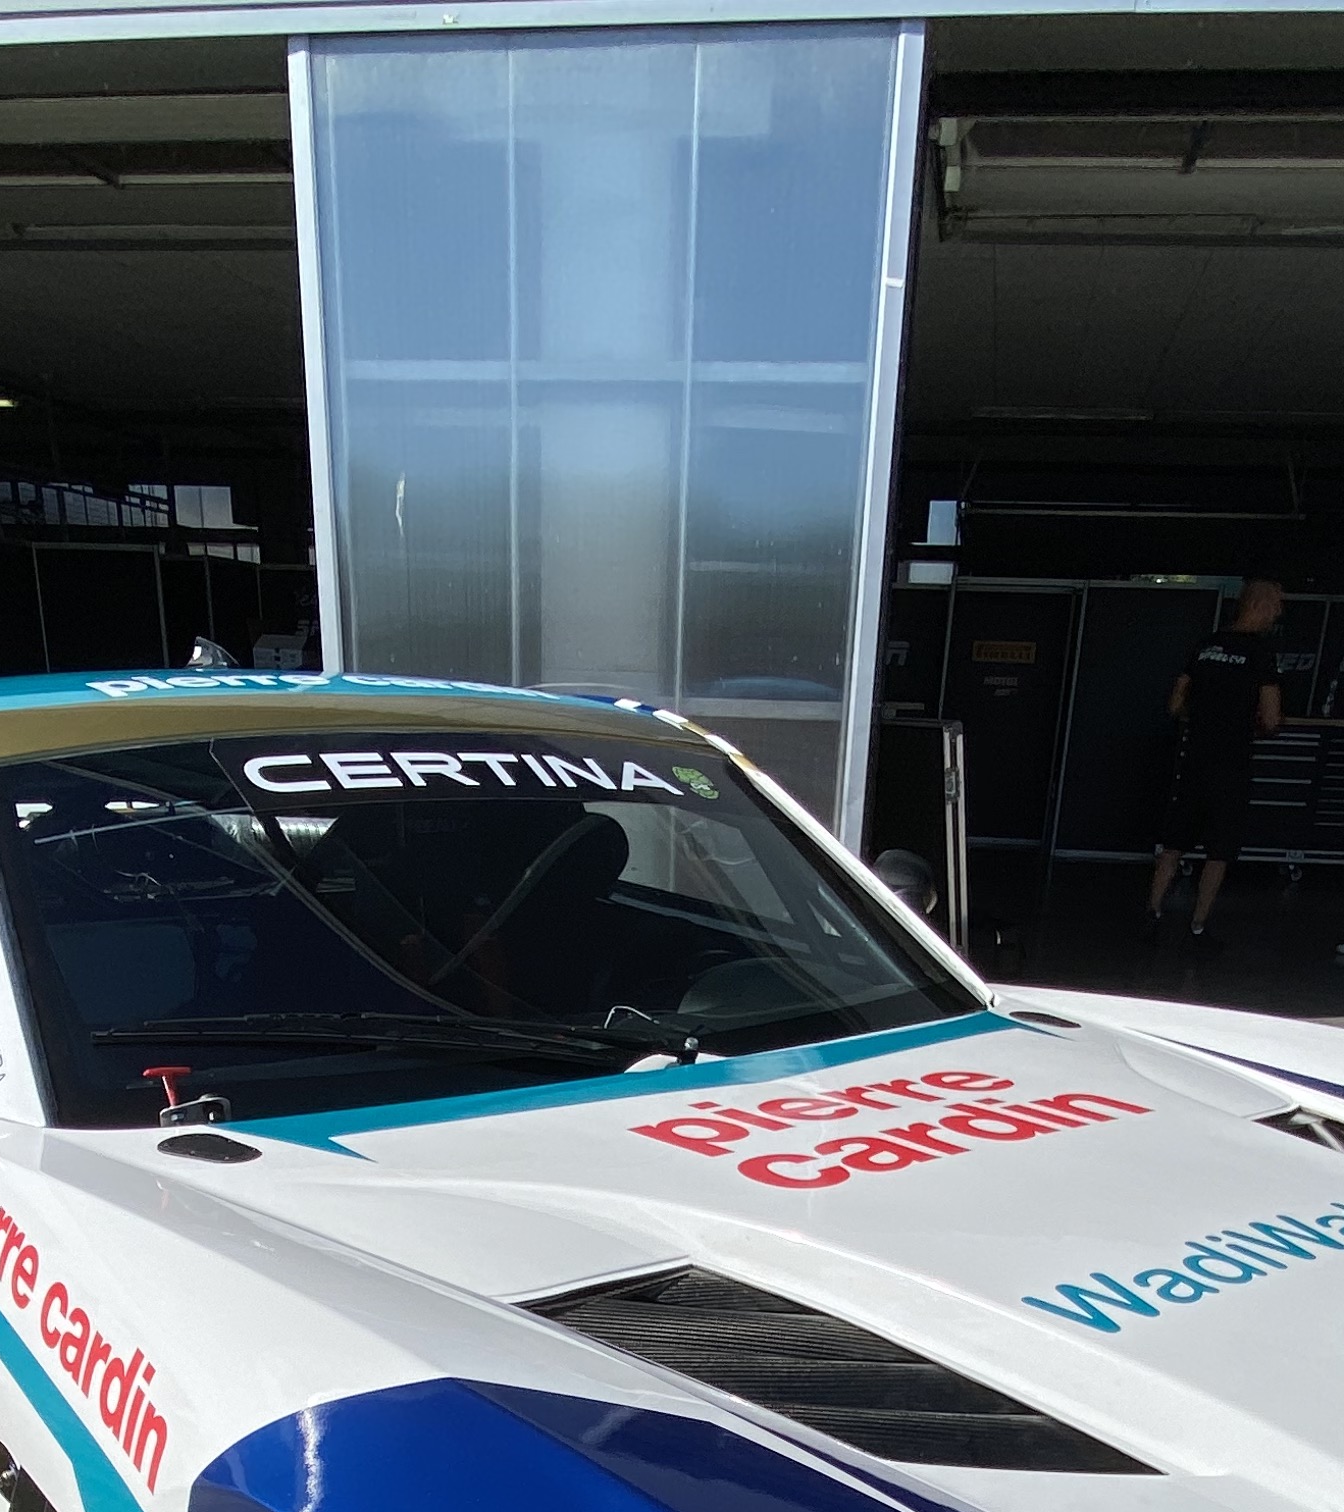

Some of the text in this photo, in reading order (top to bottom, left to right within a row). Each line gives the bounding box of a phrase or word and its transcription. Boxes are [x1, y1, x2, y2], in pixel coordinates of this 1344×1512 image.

[243, 752, 685, 797] CERTINA
[627, 1070, 1015, 1157] pierre
[737, 1092, 1157, 1189] cardin
[40, 1281, 168, 1496] cardin
